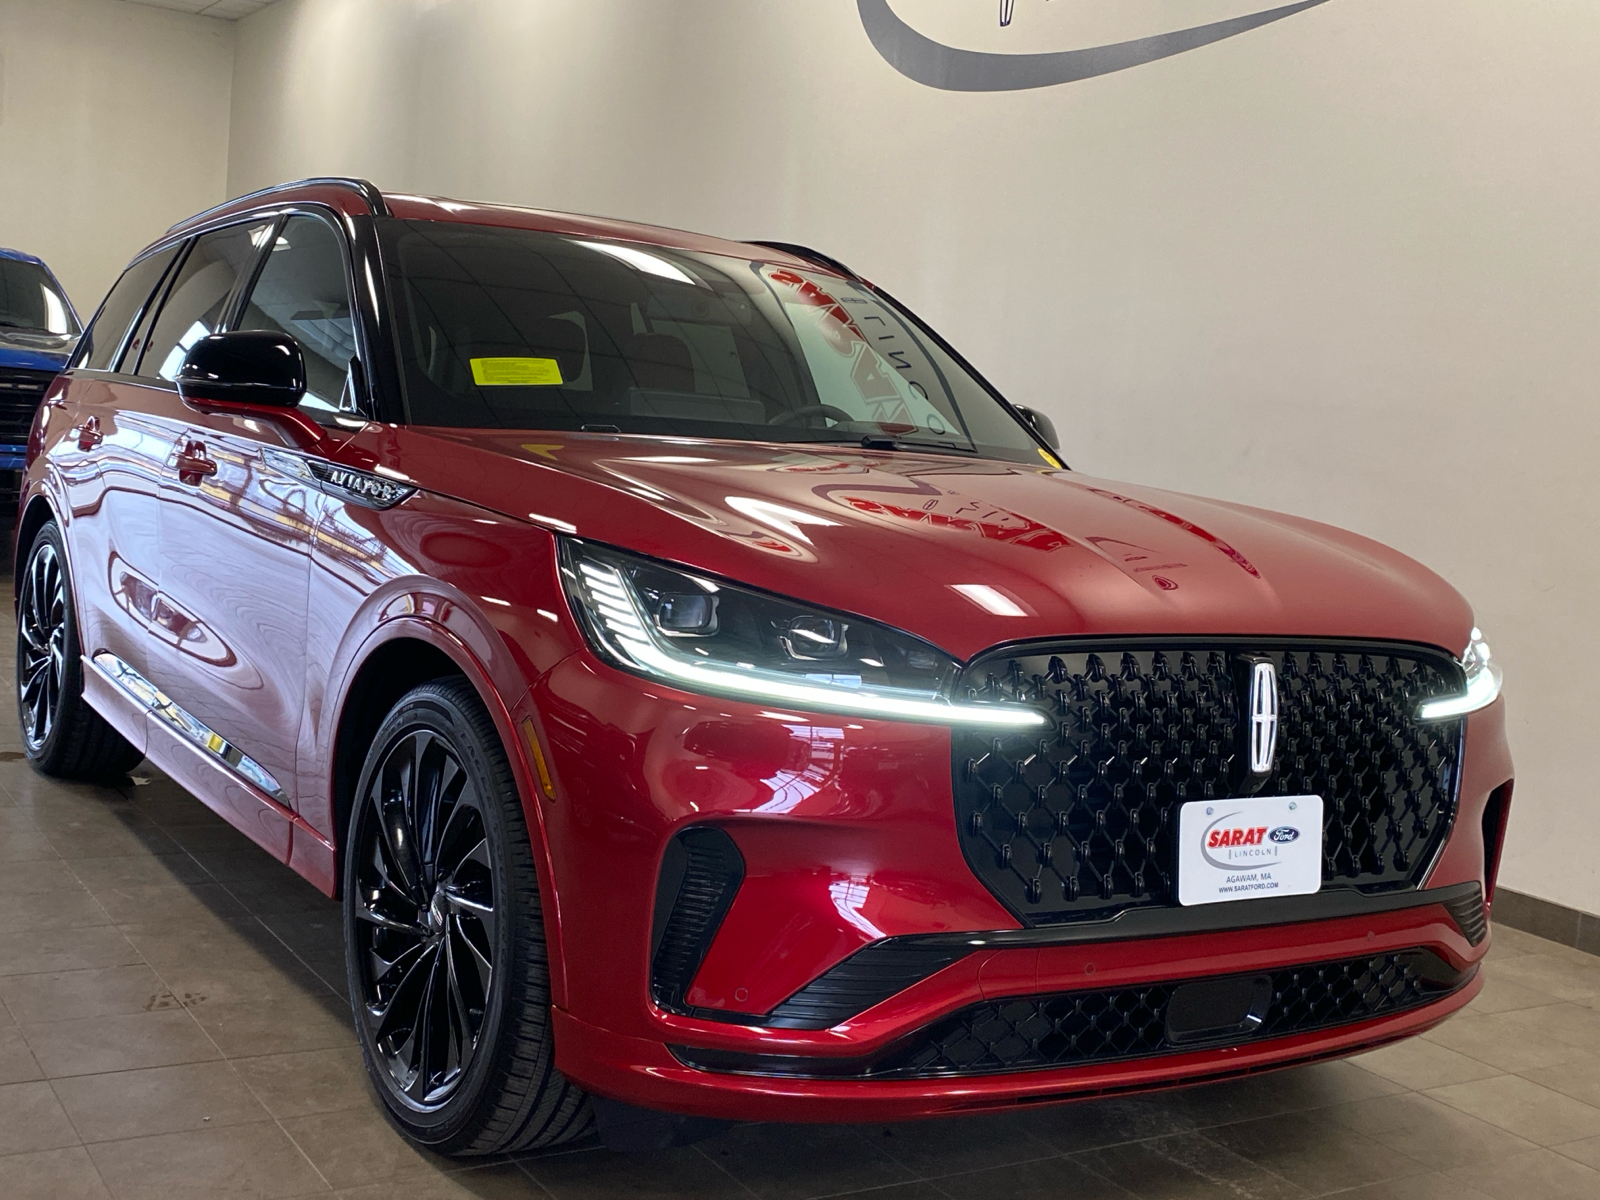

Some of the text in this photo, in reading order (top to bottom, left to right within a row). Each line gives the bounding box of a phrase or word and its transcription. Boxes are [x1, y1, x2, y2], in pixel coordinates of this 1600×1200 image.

[330, 470, 394, 501] AVIATOR
[1207, 826, 1297, 848] SARAT Ford
[1234, 848, 1272, 858] LINCOLN
[1226, 872, 1272, 883] AGAWAM, MA
[1219, 882, 1279, 893] WWW.SARATFORD.COM
